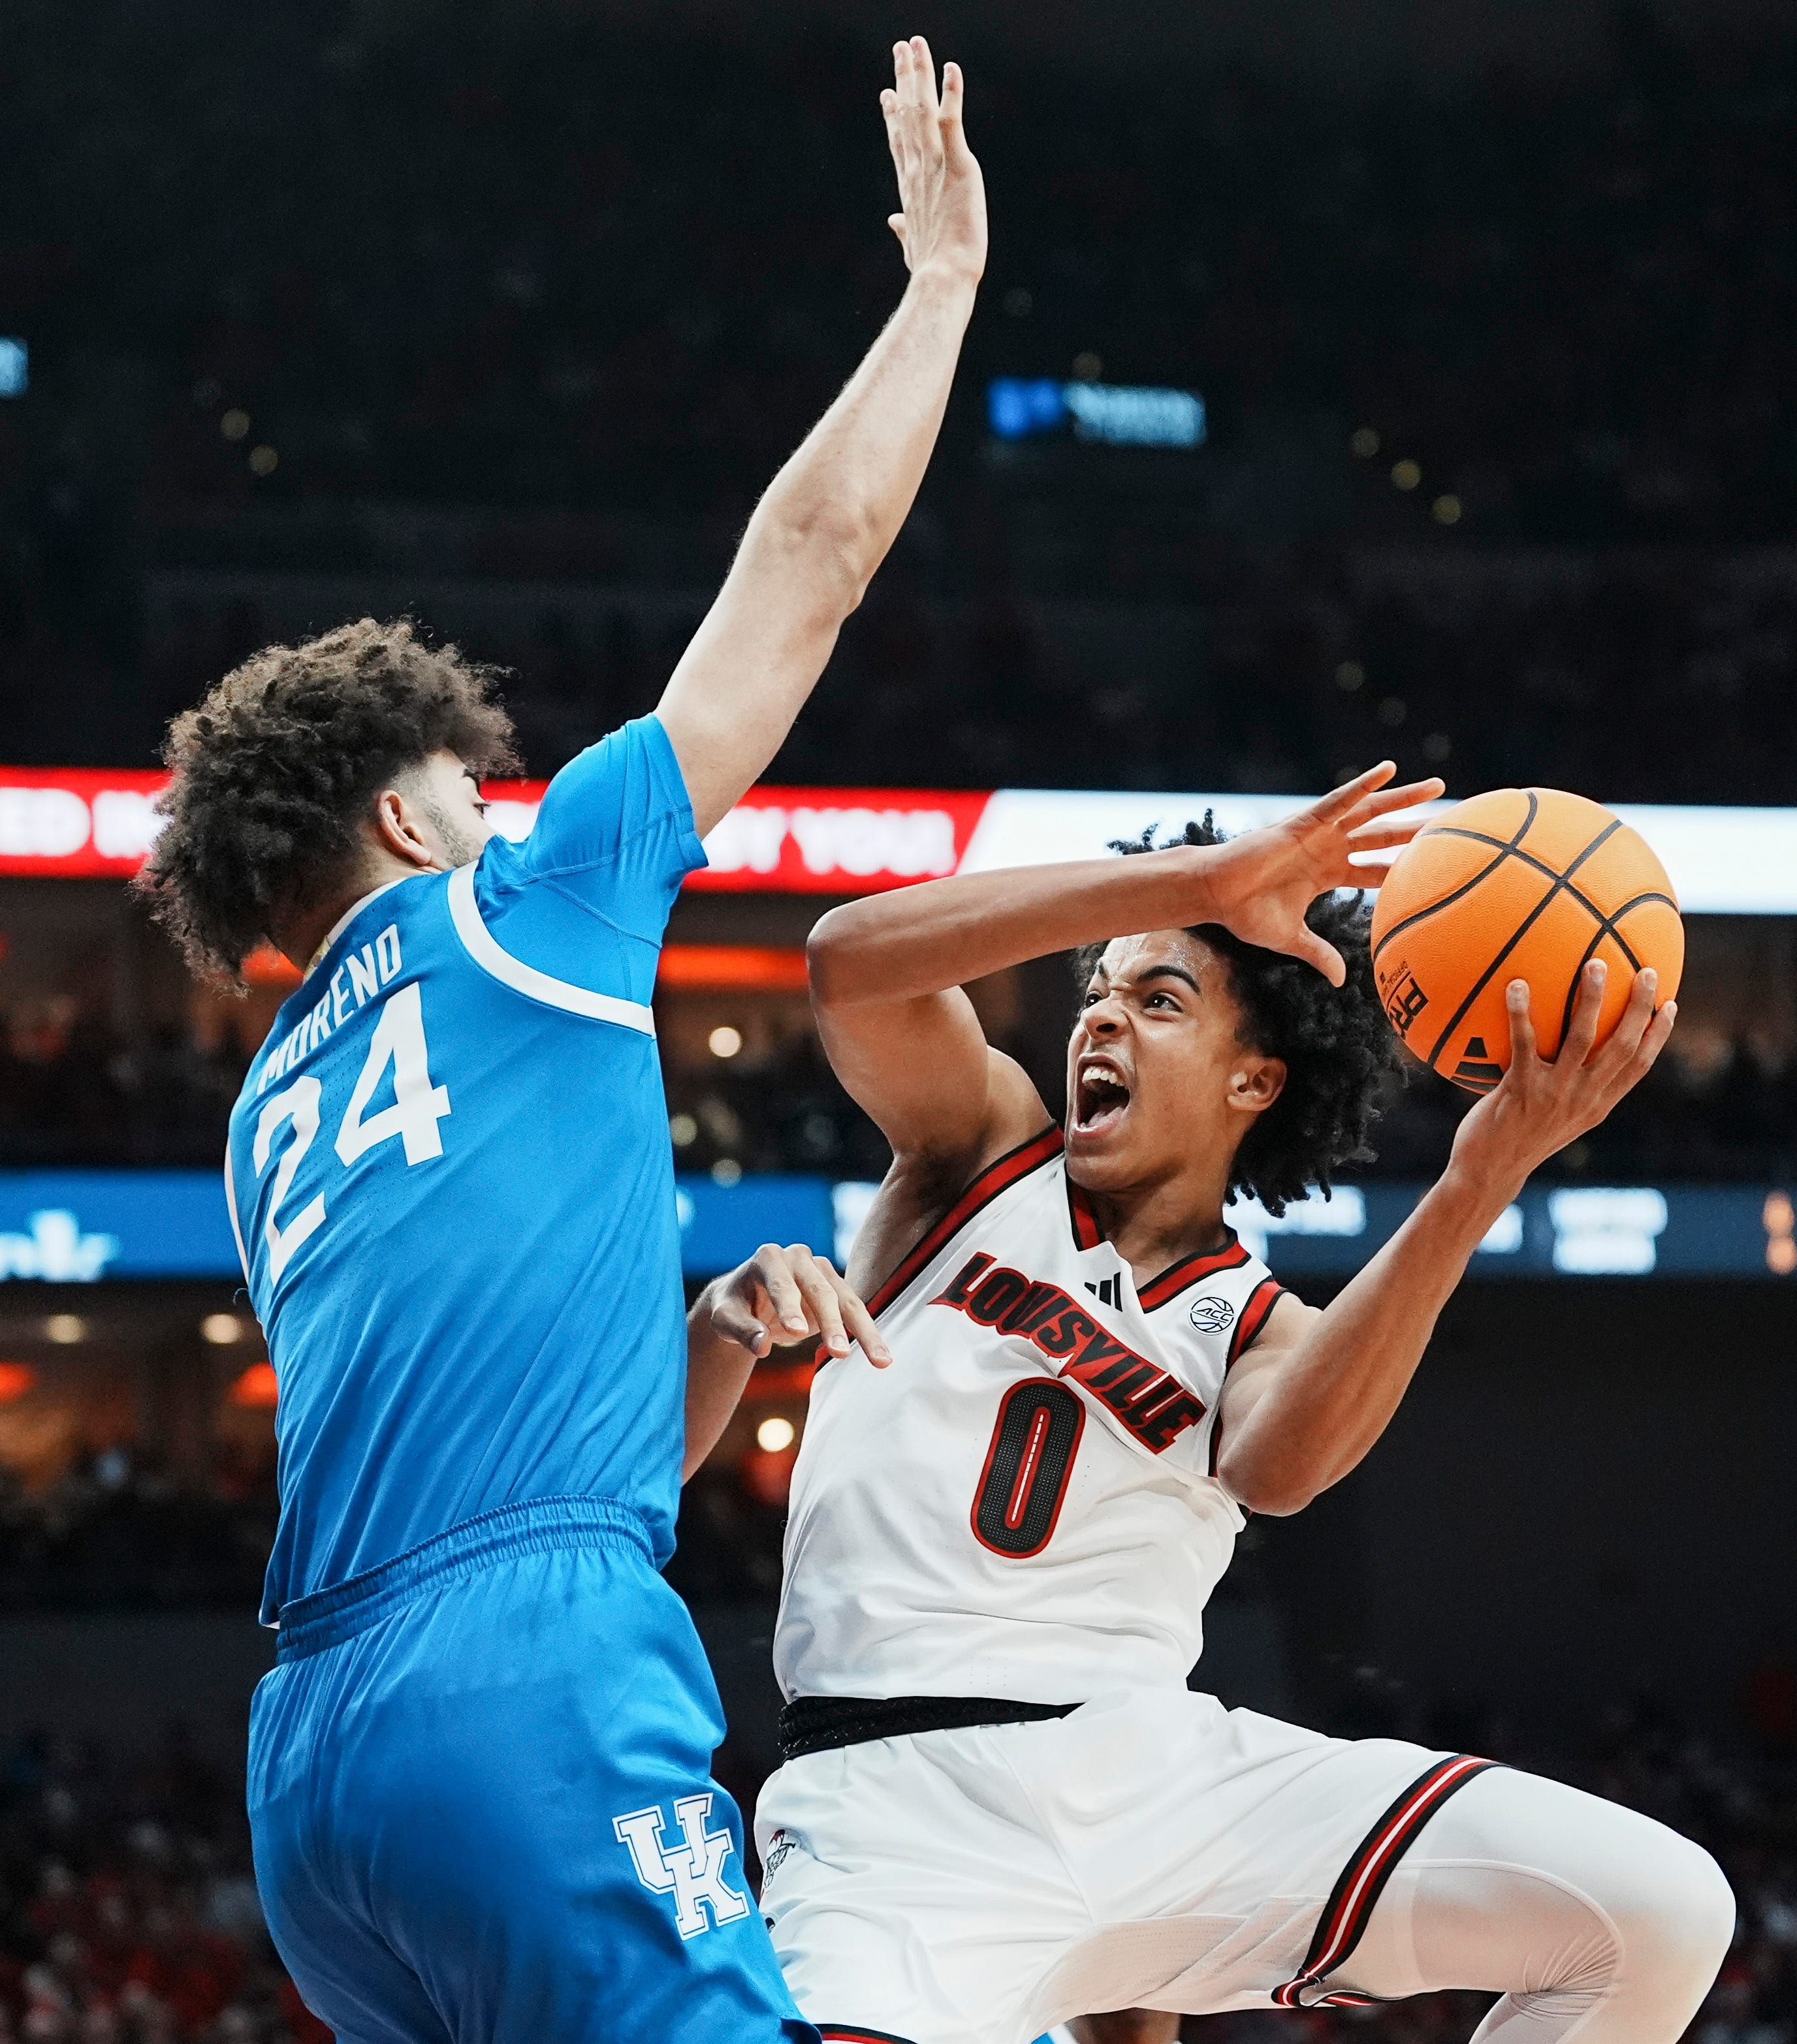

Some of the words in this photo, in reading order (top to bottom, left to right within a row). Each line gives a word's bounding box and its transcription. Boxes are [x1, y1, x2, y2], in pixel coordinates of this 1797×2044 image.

[257, 924, 402, 1095] MORENO
[253, 981, 451, 1287] 24
[928, 1251, 1207, 1454] LOUISVILLE
[1196, 1308, 1233, 1322] ACC
[970, 1377, 1086, 1559] 0
[612, 1793, 750, 1941] UK
